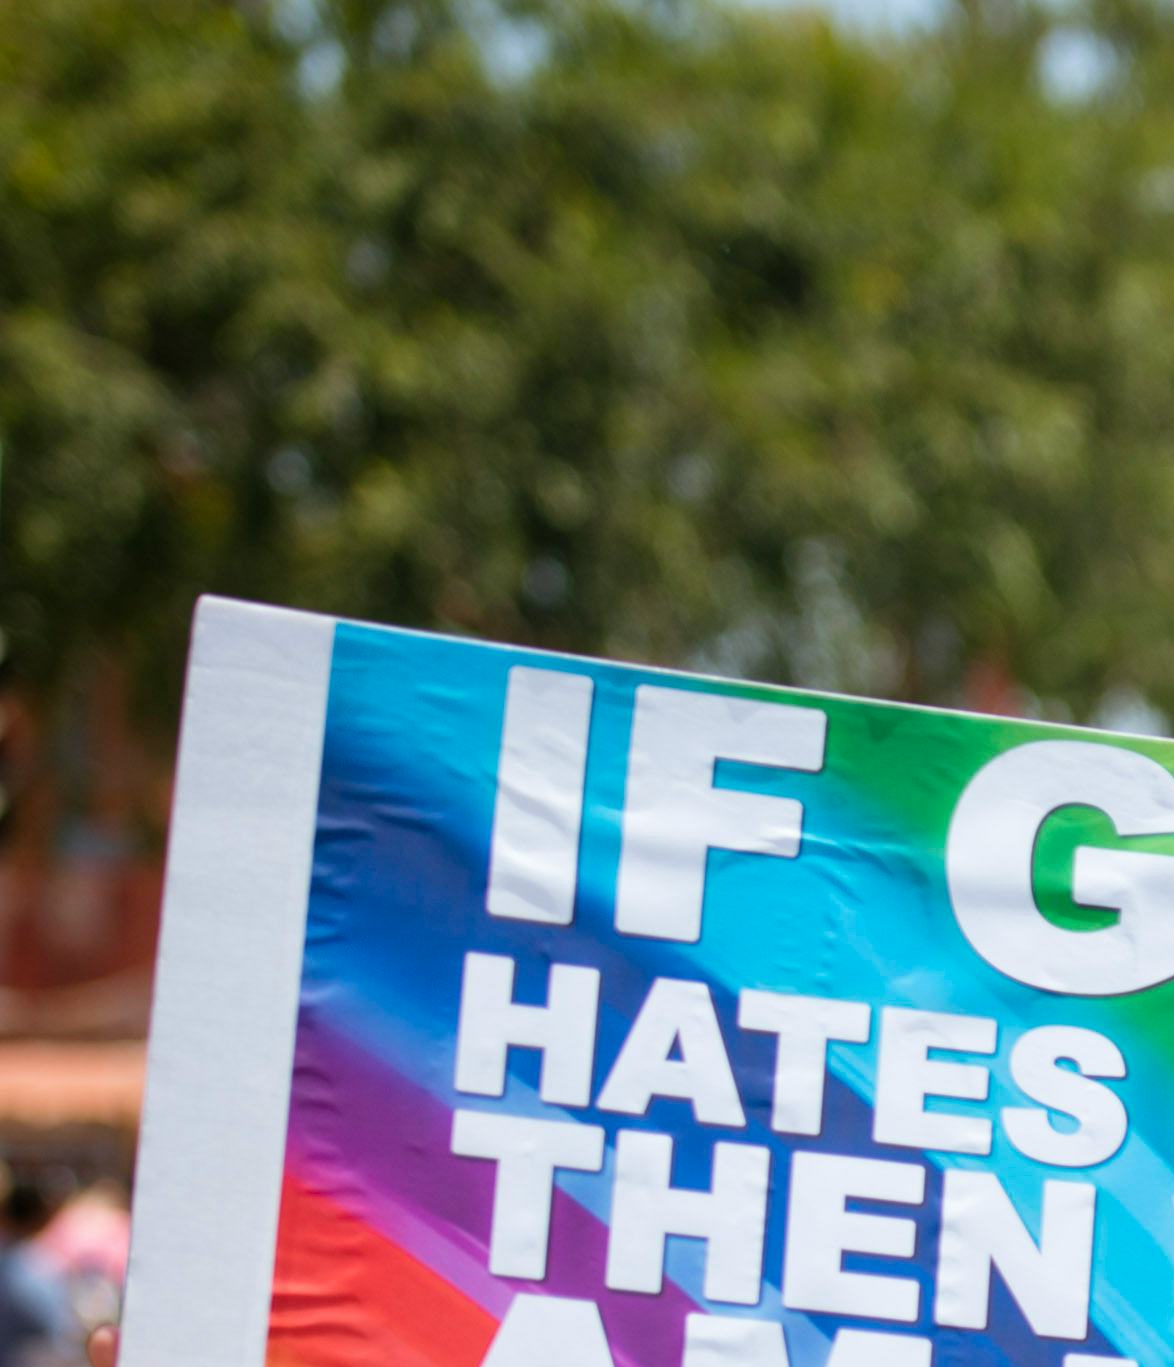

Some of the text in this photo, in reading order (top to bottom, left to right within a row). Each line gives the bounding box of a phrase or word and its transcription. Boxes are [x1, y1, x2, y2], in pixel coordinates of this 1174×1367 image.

[487, 669, 828, 941] IF
[453, 953, 1129, 1167] HATES
[449, 1109, 1096, 1341] THEN
